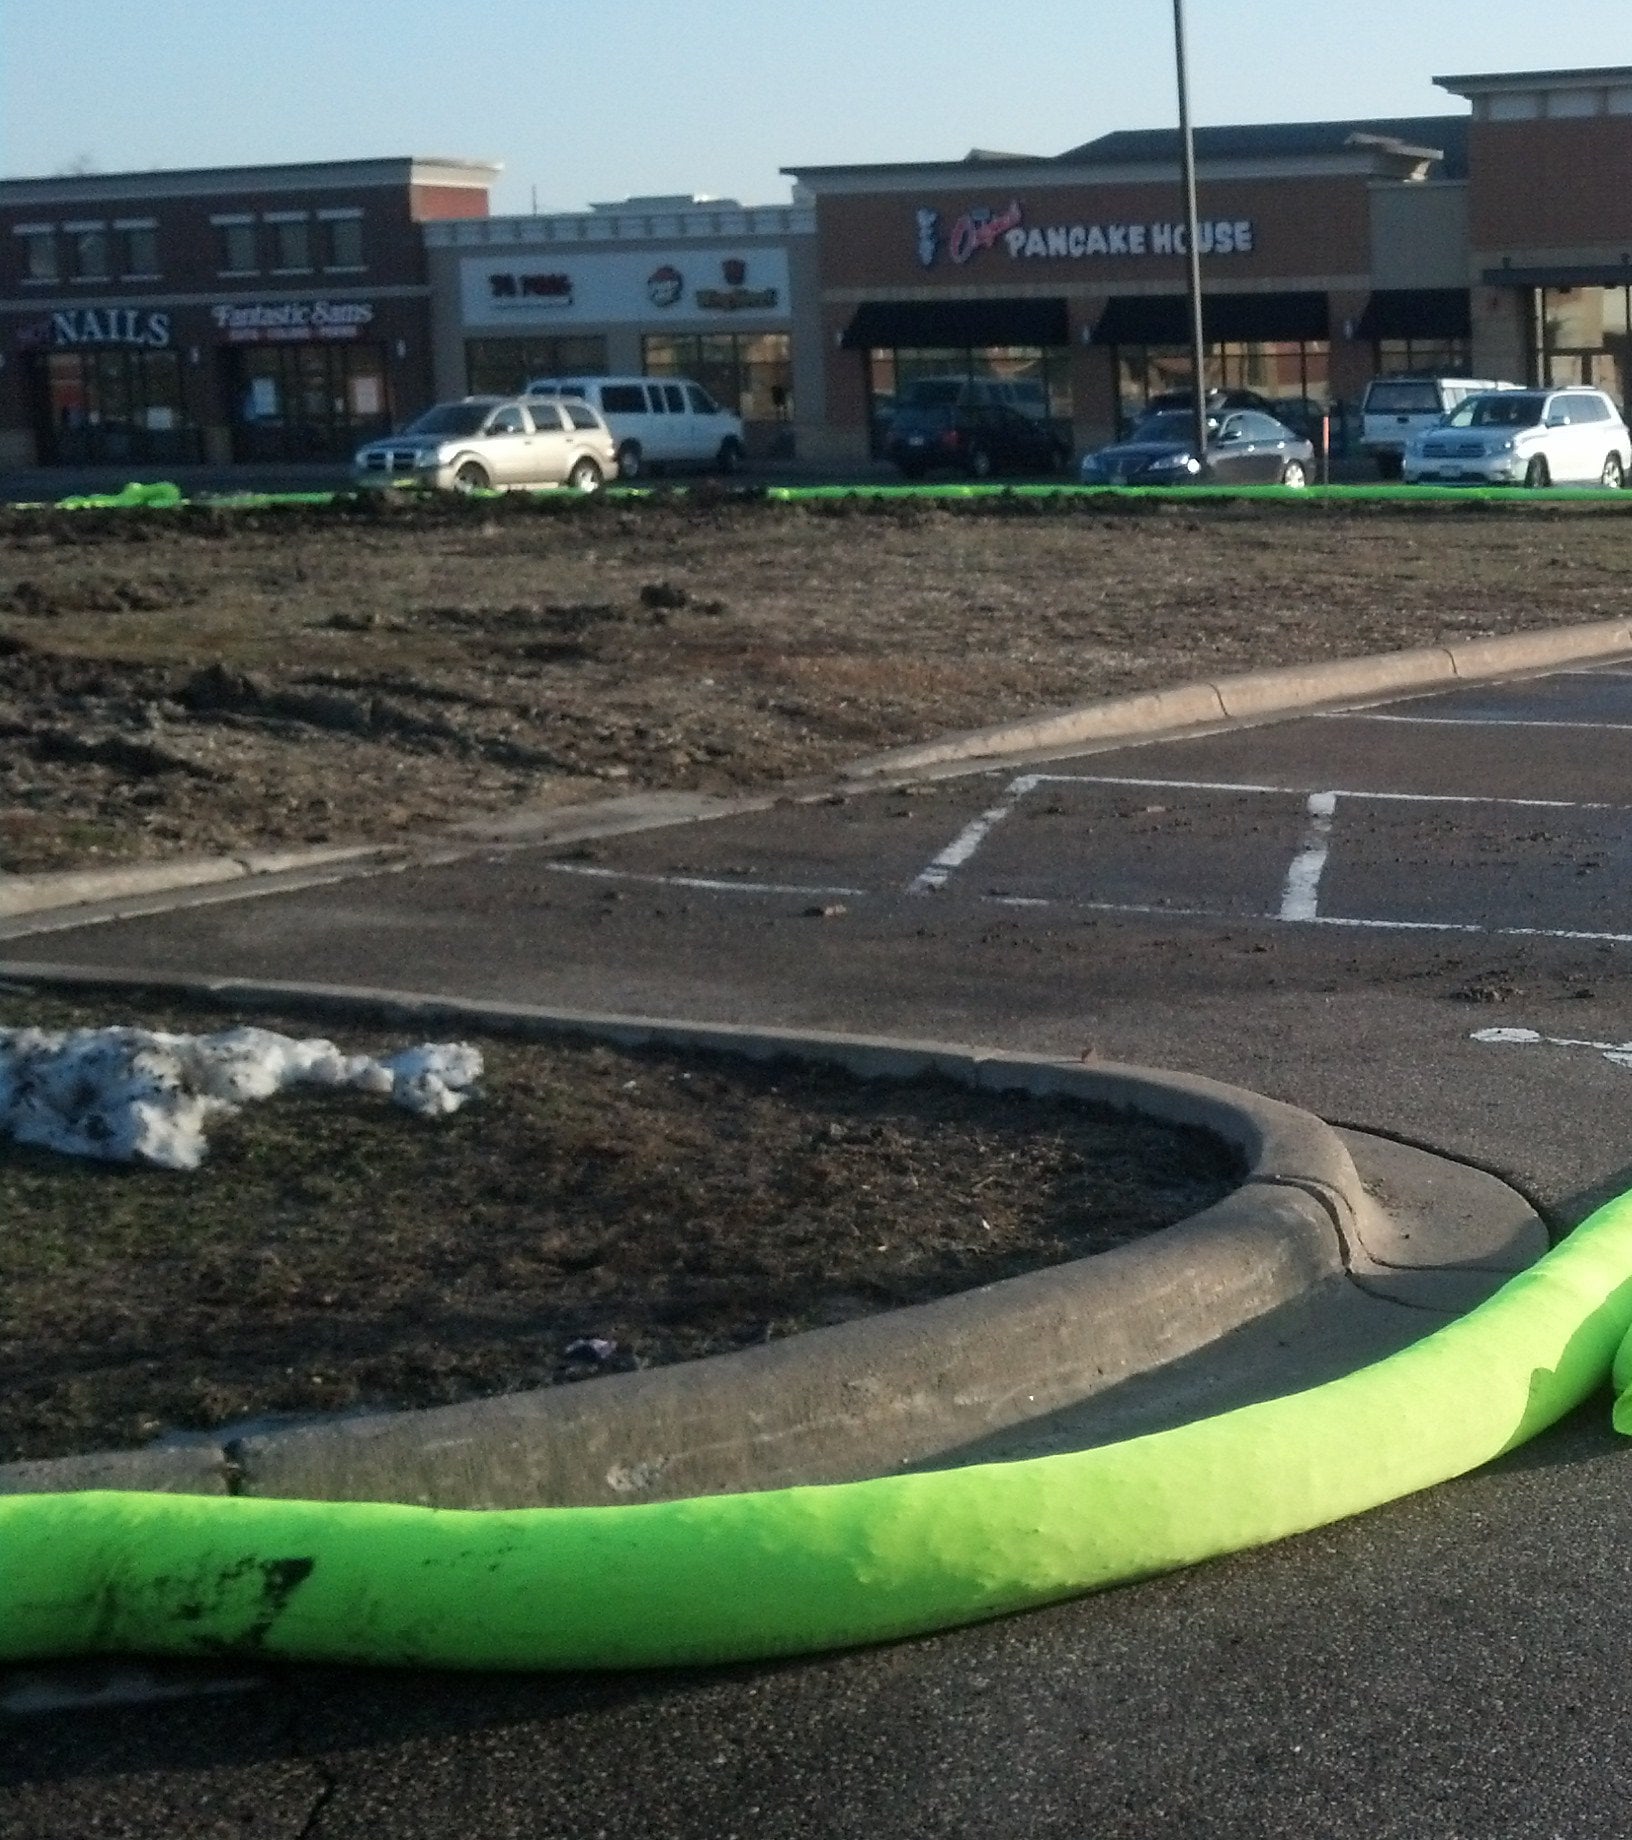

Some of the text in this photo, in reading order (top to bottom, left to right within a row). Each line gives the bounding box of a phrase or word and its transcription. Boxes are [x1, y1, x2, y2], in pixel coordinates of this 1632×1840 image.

[1004, 224, 1147, 258] PANCAKE
[1151, 220, 1254, 253] HOUSE
[52, 308, 170, 348] NAILS
